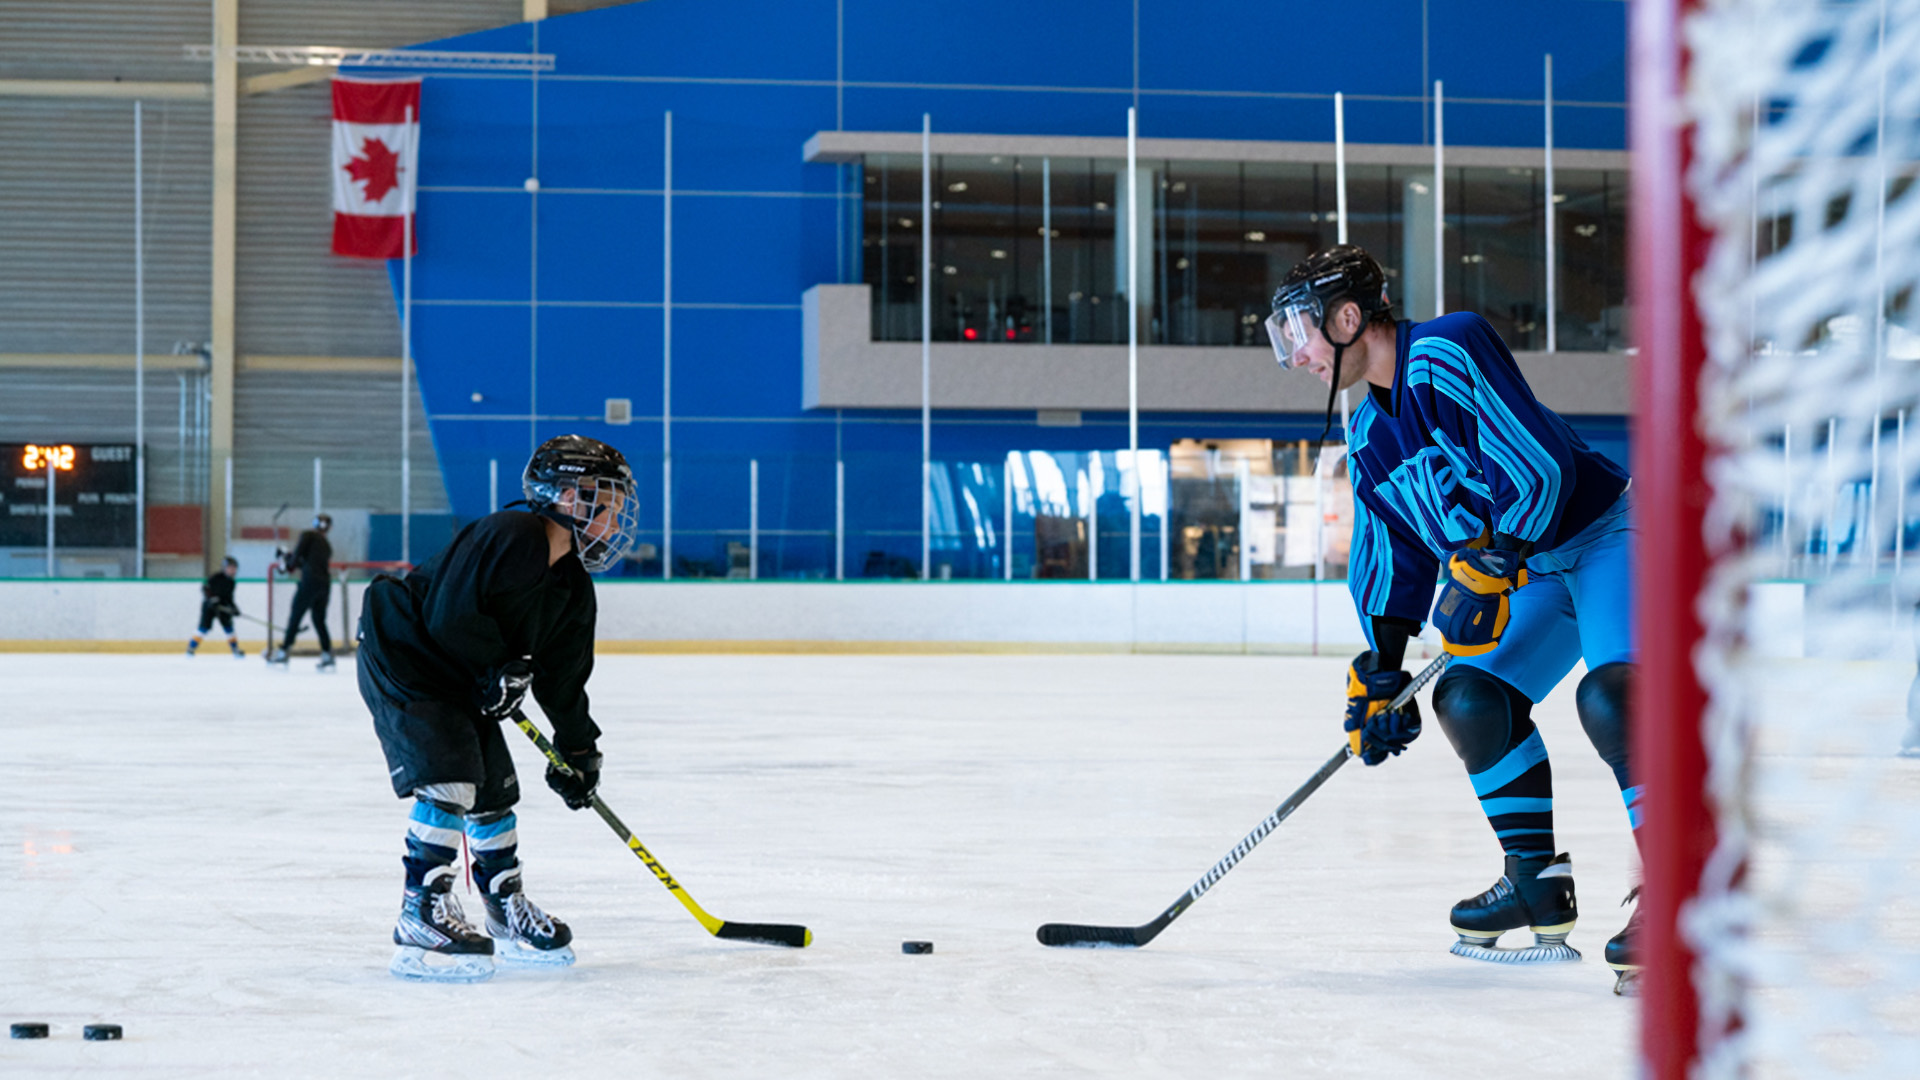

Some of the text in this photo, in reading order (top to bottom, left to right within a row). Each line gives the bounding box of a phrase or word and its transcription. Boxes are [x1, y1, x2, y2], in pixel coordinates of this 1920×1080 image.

[22, 444, 76, 470] 2:42
[91, 446, 131, 461] GUEST
[631, 845, 680, 890] CCM
[1188, 809, 1281, 901] WARRIOR
